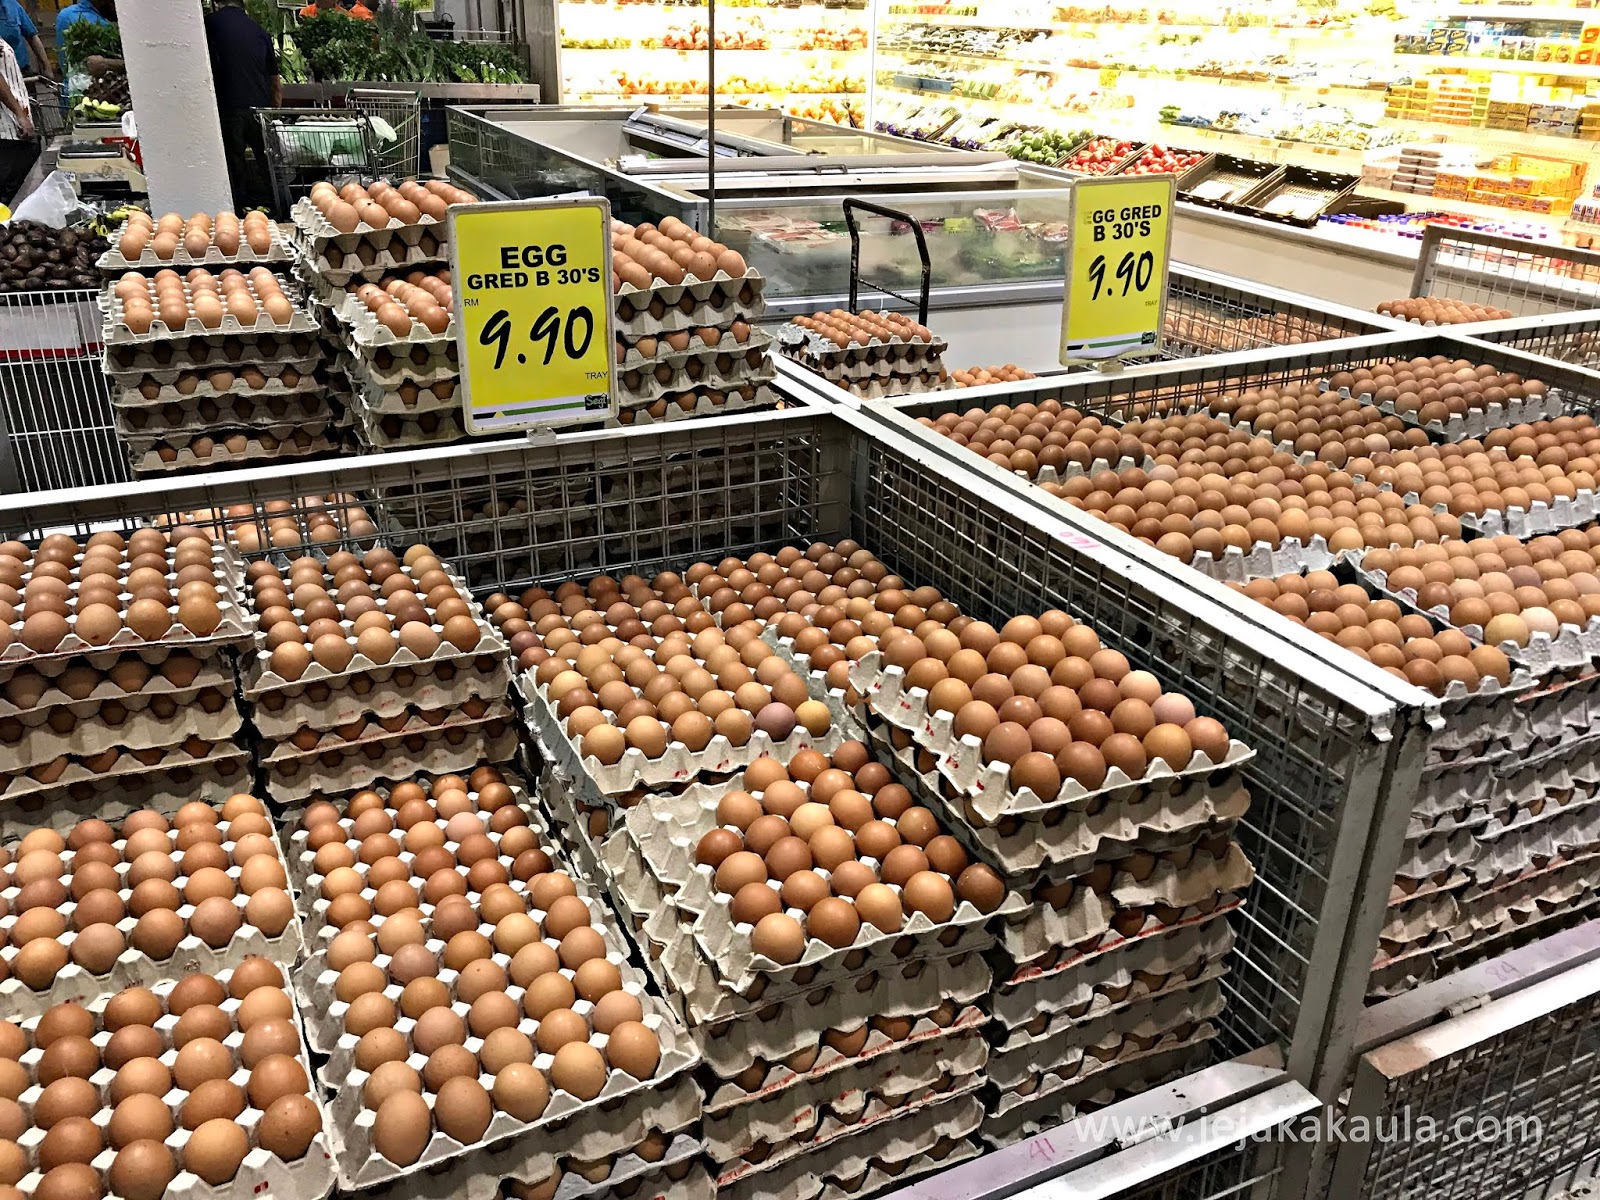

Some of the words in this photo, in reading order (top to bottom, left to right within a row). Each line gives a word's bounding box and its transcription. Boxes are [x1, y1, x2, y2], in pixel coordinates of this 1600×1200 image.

[1120, 204, 1162, 221] GRED
[1093, 225, 1106, 242] B
[1112, 220, 1151, 240] 30'S
[501, 244, 568, 269] EGG
[467, 271, 529, 290] GRED
[536, 270, 550, 286] B
[557, 267, 601, 285] 30'S
[1087, 250, 1154, 301] 9.90
[464, 298, 479, 307] RM
[479, 305, 594, 370] 9.90
[584, 370, 609, 380] TRAY
